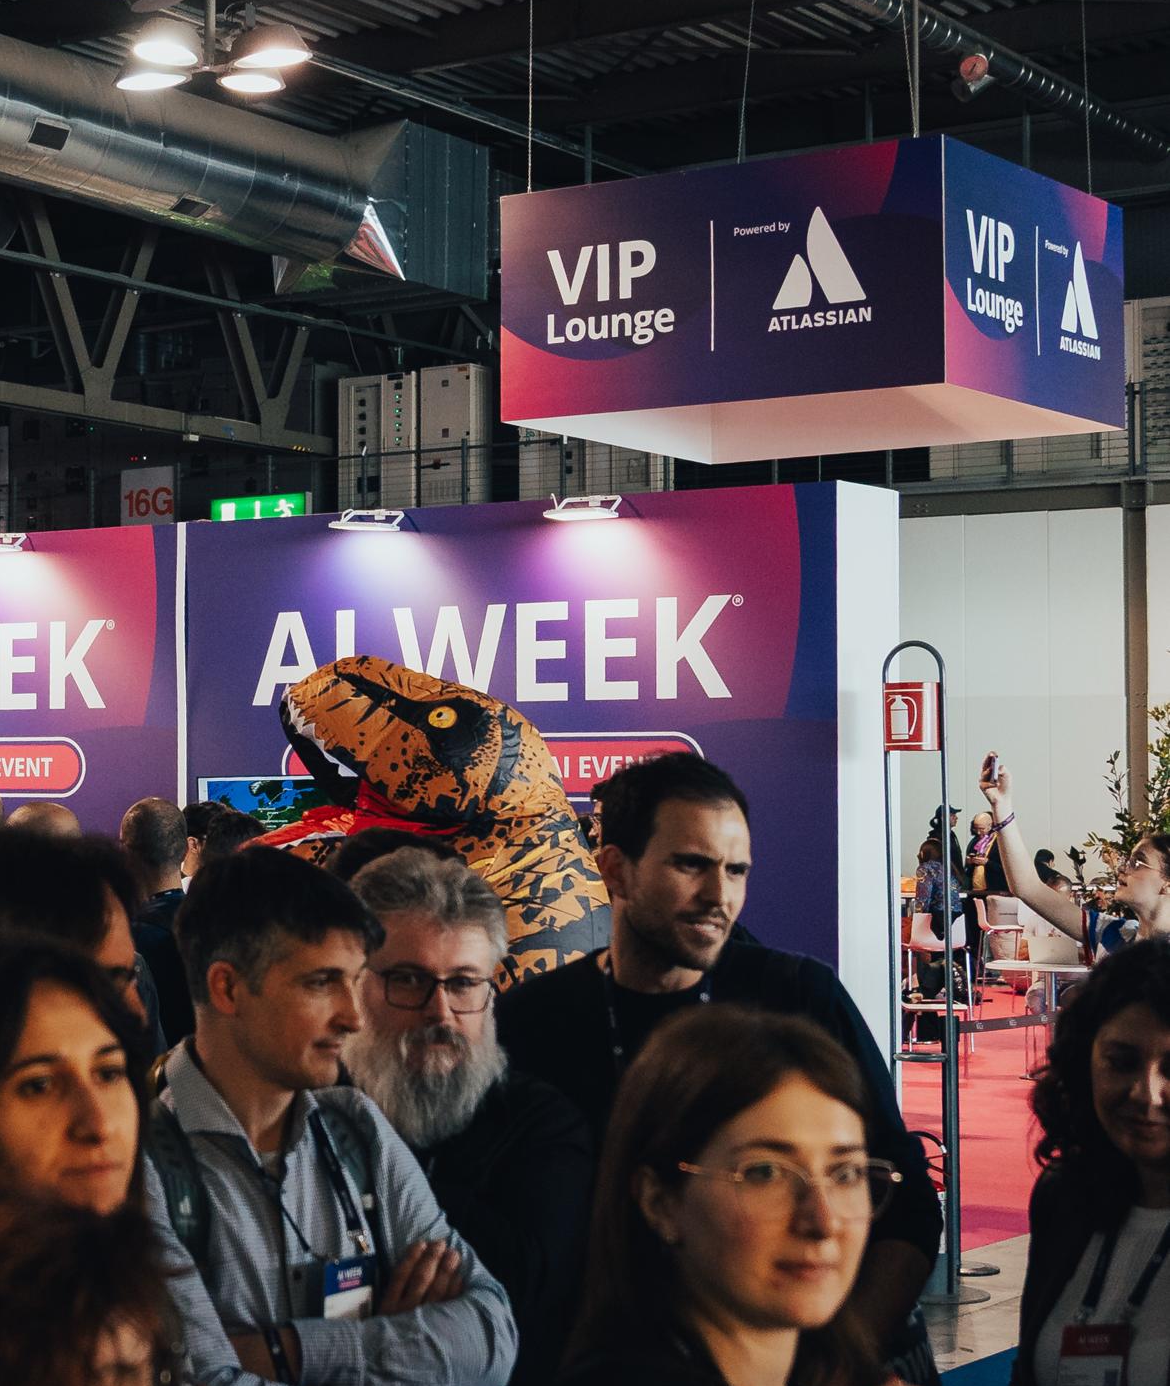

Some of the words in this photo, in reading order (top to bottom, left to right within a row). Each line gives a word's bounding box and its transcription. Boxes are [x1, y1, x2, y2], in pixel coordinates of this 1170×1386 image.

[733, 223, 776, 237] Powered
[778, 221, 790, 233] by
[965, 208, 1016, 283] VIP
[546, 239, 657, 306] VIP
[767, 306, 872, 332] ATLASSIAN
[966, 277, 1024, 333] Lounge
[546, 307, 675, 345] Lounge
[1059, 335, 1101, 361] ATLASSIAN
[124, 486, 174, 518] 16G
